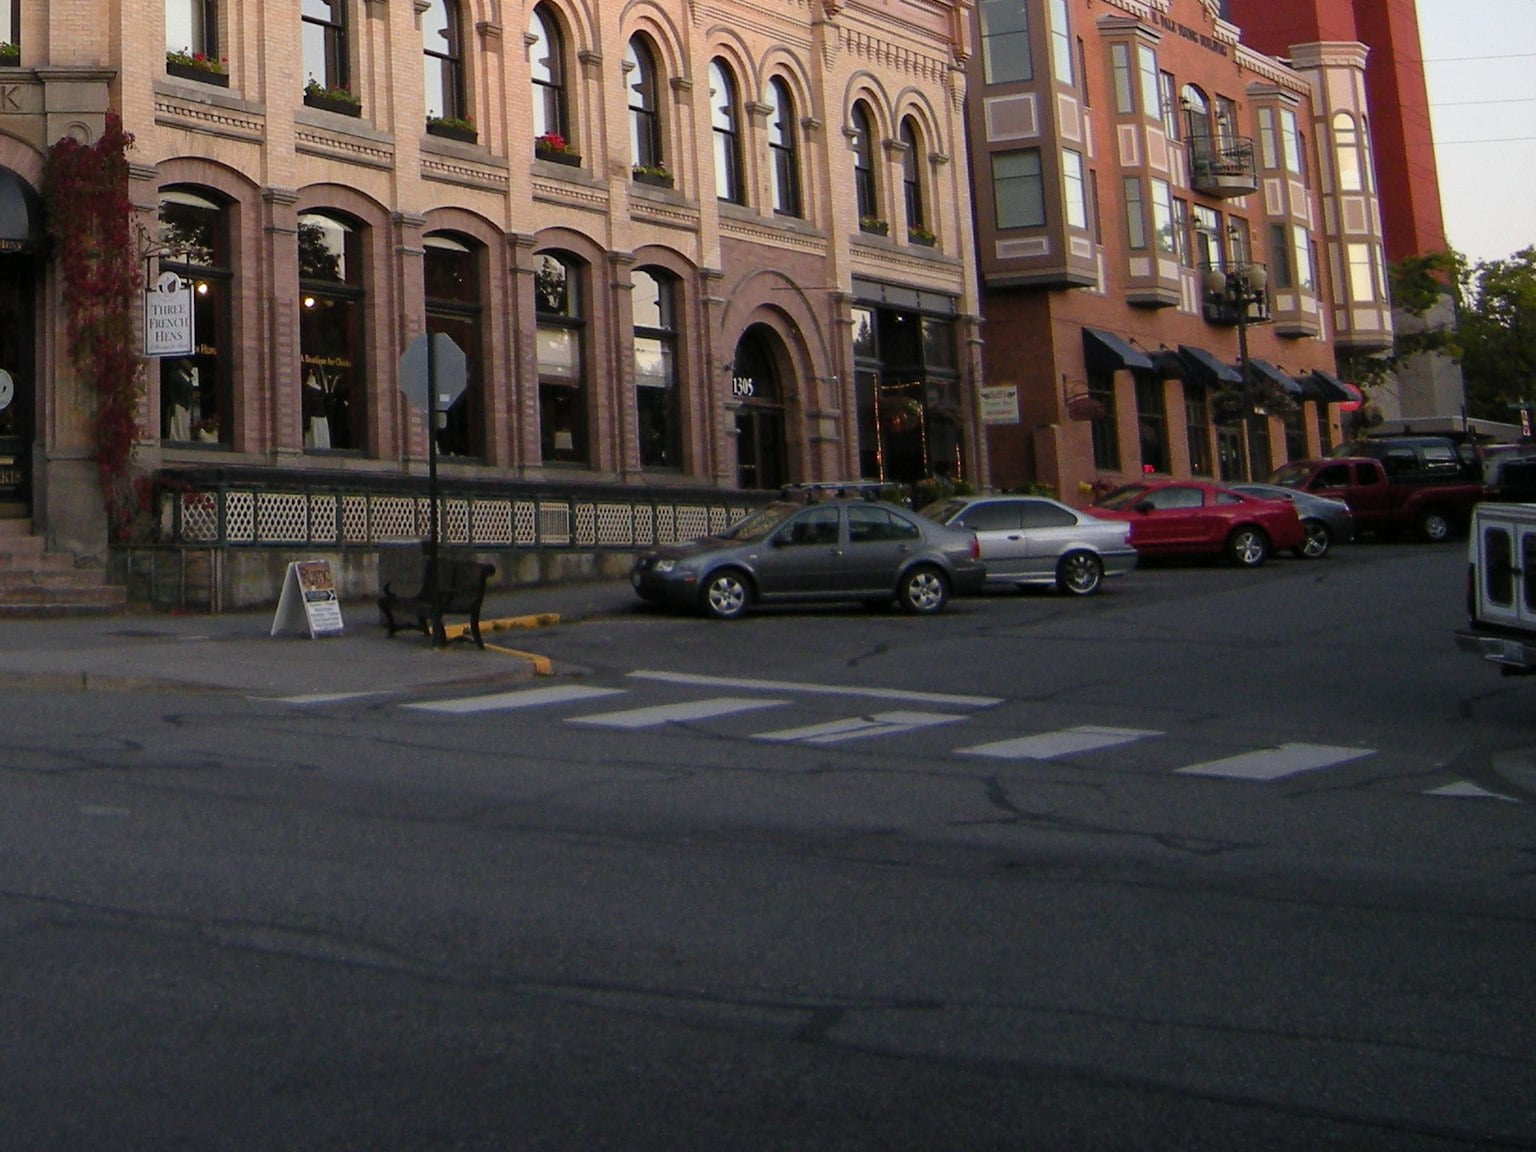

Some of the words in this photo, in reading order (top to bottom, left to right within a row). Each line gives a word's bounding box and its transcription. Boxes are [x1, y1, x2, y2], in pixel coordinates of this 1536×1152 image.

[152, 304, 186, 315] THREE
[149, 317, 190, 329] FRENCH
[156, 331, 183, 342] HENS
[733, 377, 754, 396] 1305
